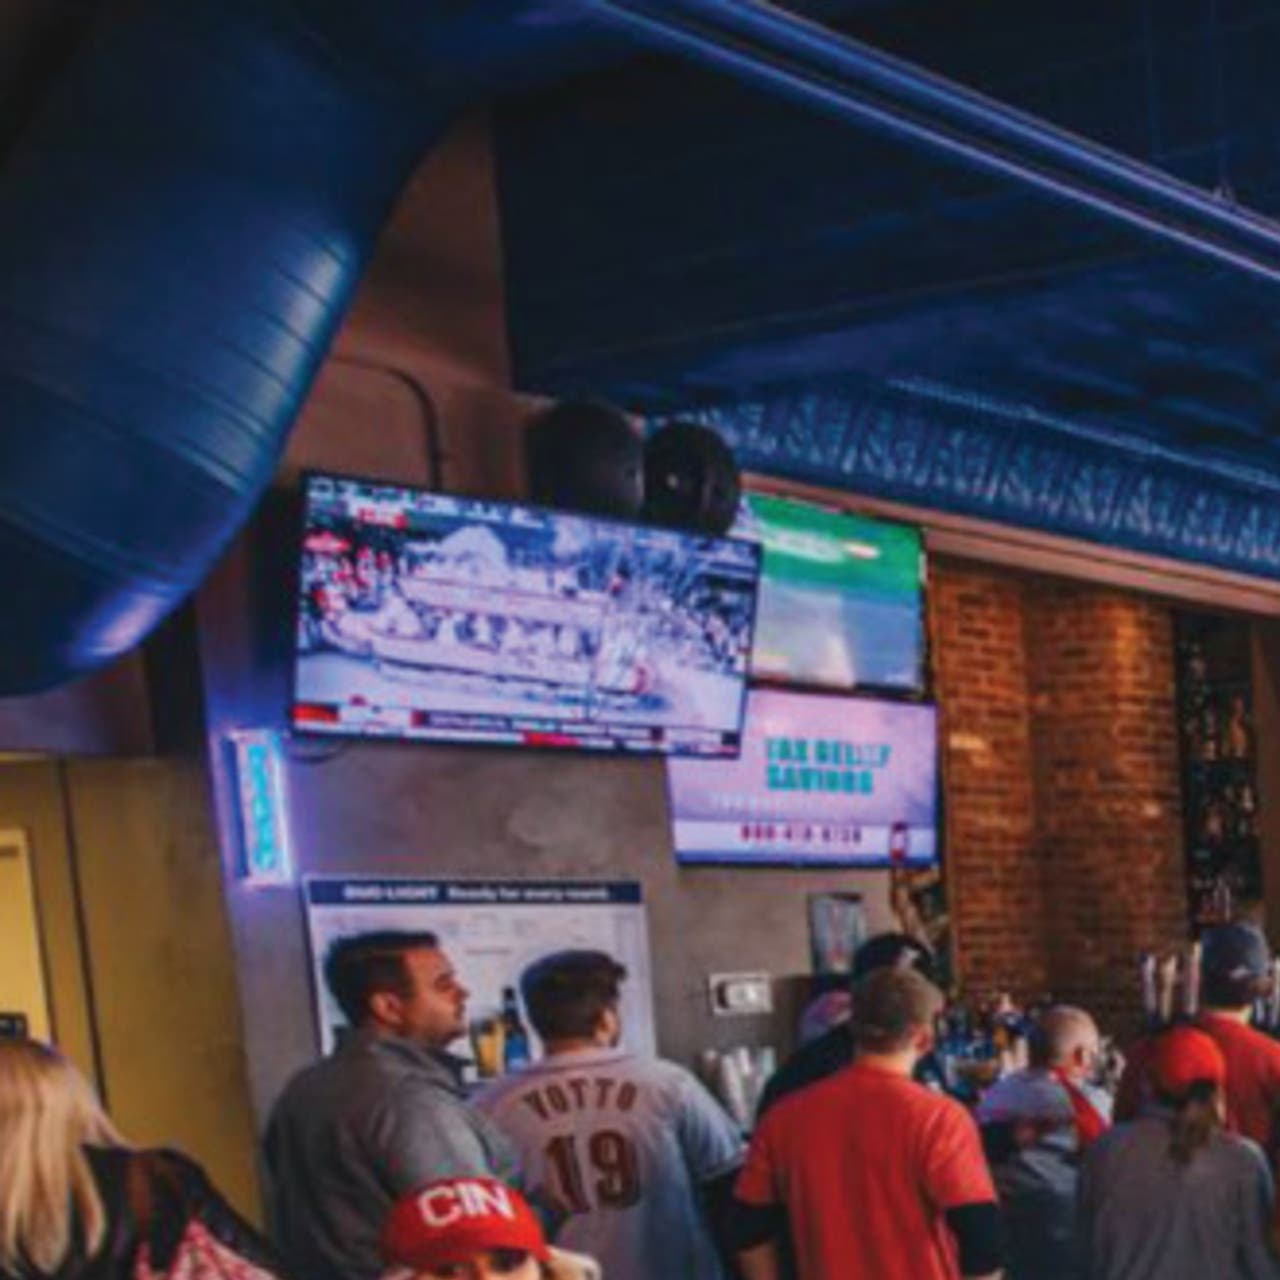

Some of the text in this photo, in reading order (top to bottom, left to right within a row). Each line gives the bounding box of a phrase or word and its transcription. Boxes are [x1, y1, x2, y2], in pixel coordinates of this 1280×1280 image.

[522, 1077, 638, 1121] VOTTO
[545, 1130, 640, 1214] 19
[418, 1182, 515, 1227] CIN
